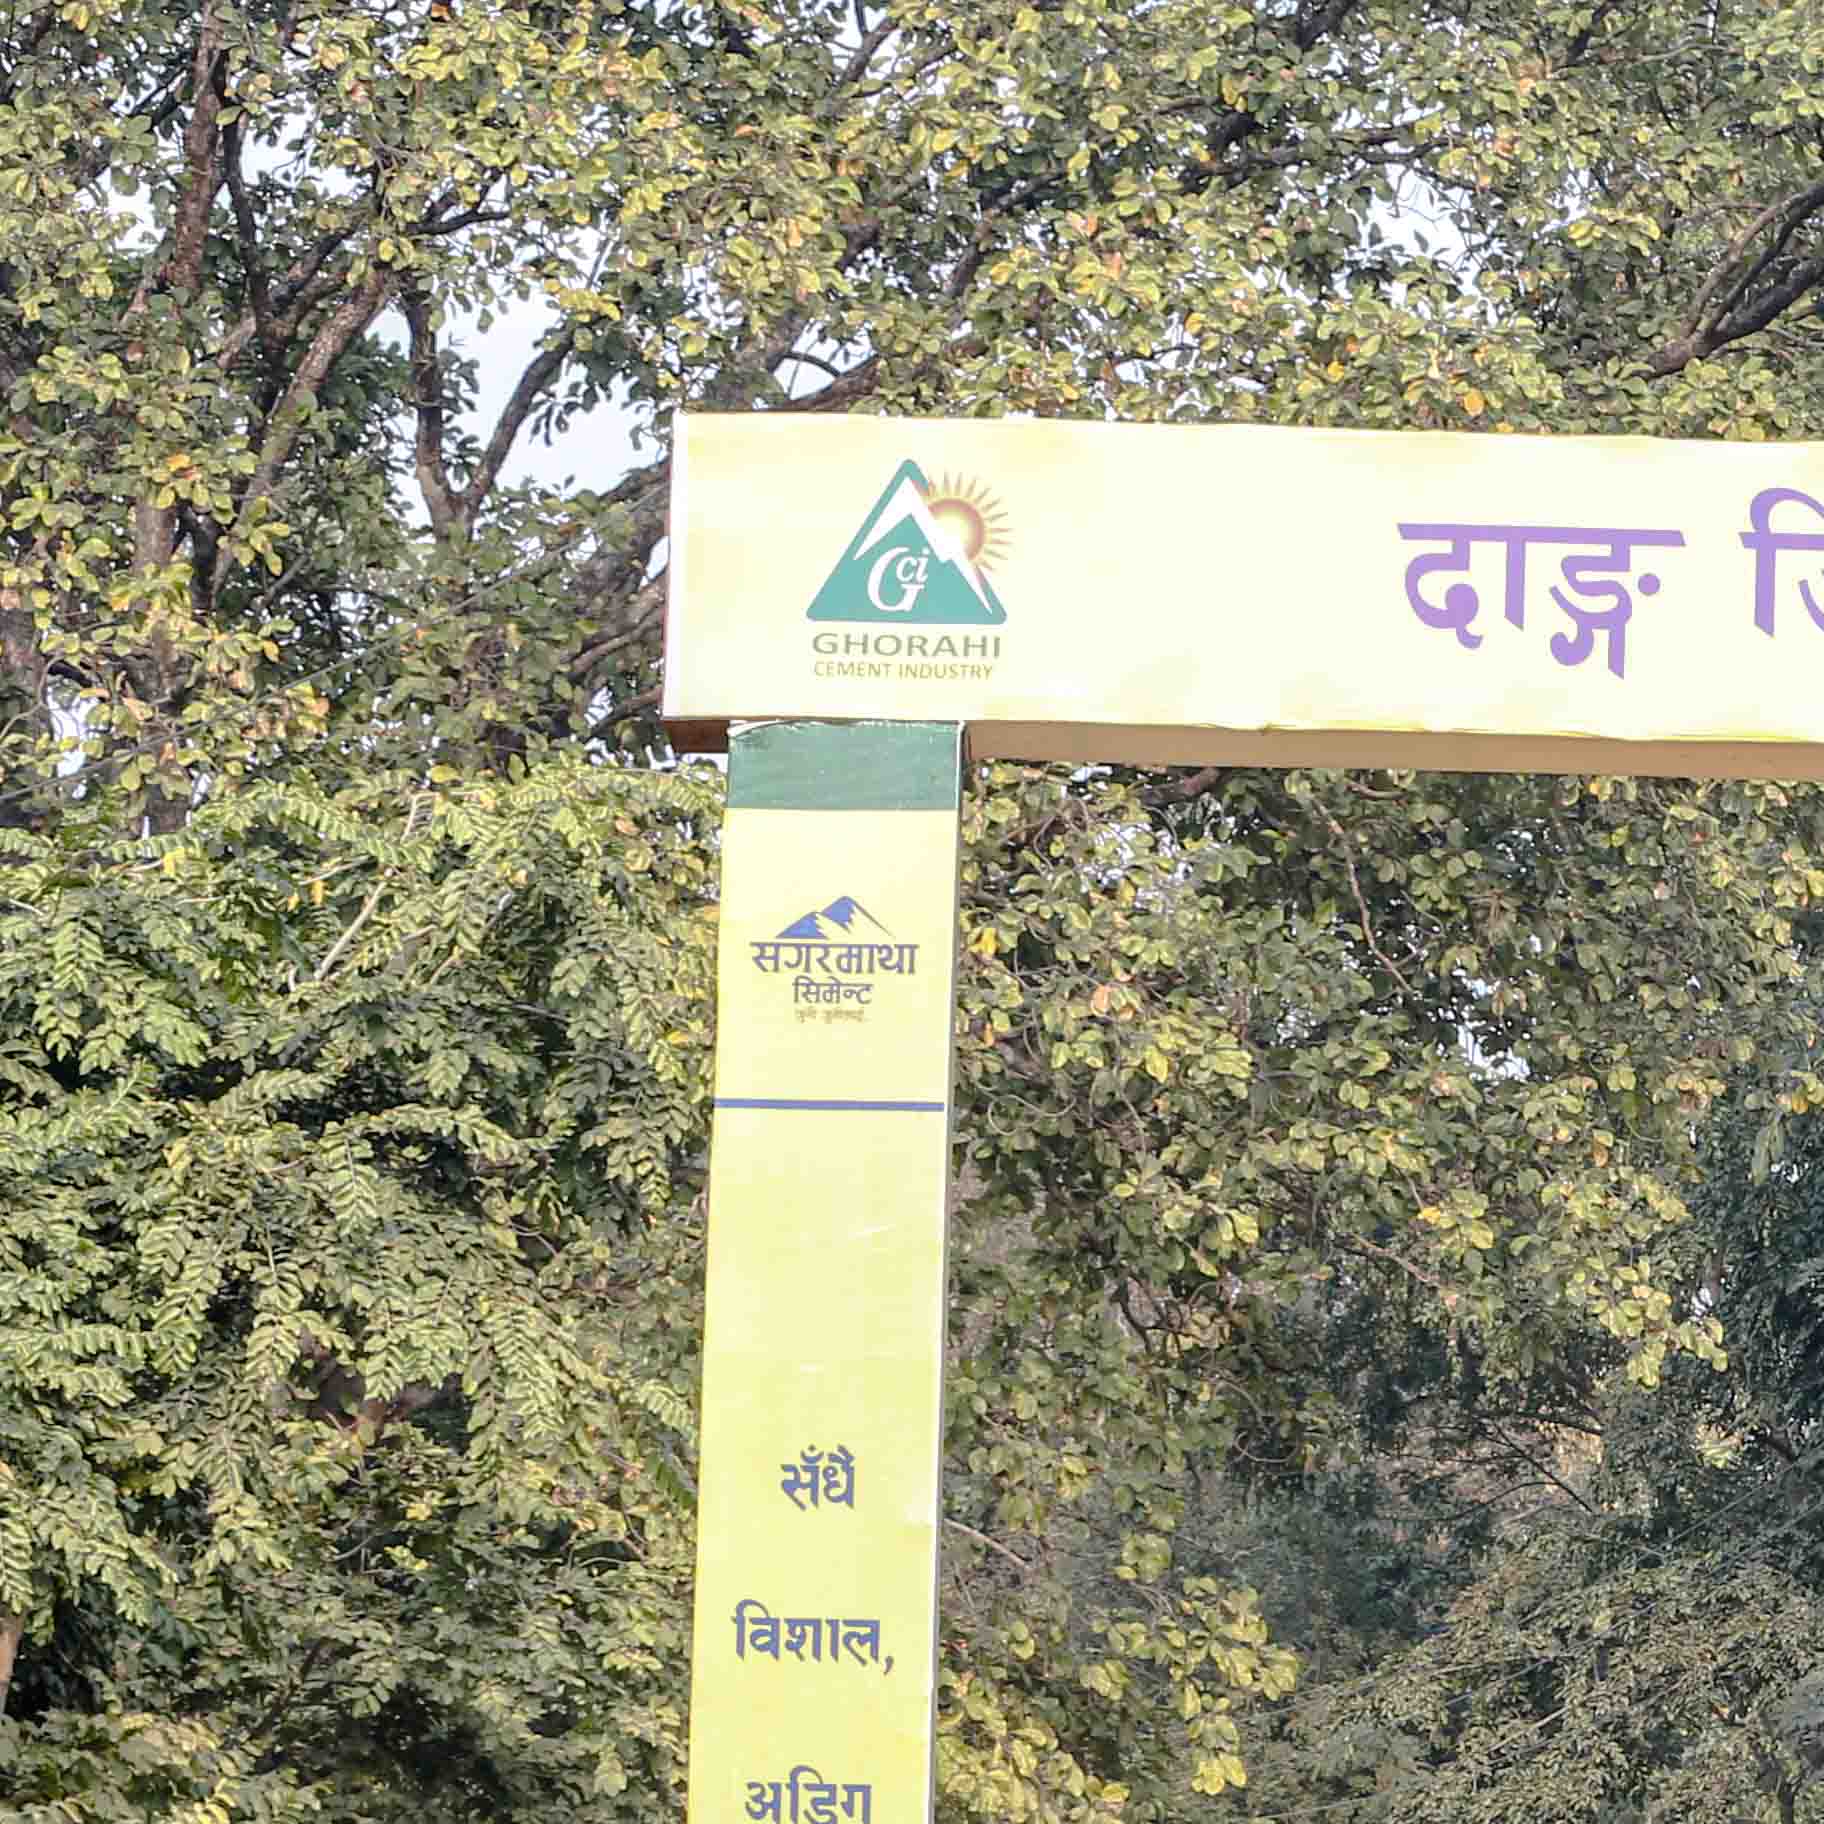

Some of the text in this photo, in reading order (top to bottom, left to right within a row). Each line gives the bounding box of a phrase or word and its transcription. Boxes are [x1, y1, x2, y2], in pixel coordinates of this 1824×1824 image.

[812, 633, 1001, 659] GHORAHI
[814, 660, 994, 680] CEMENT INDUSTRY
[749, 941, 920, 974] सगरमाथा
[792, 975, 874, 1005] सिमेन्ट
[731, 1599, 895, 1675] विशाल,
